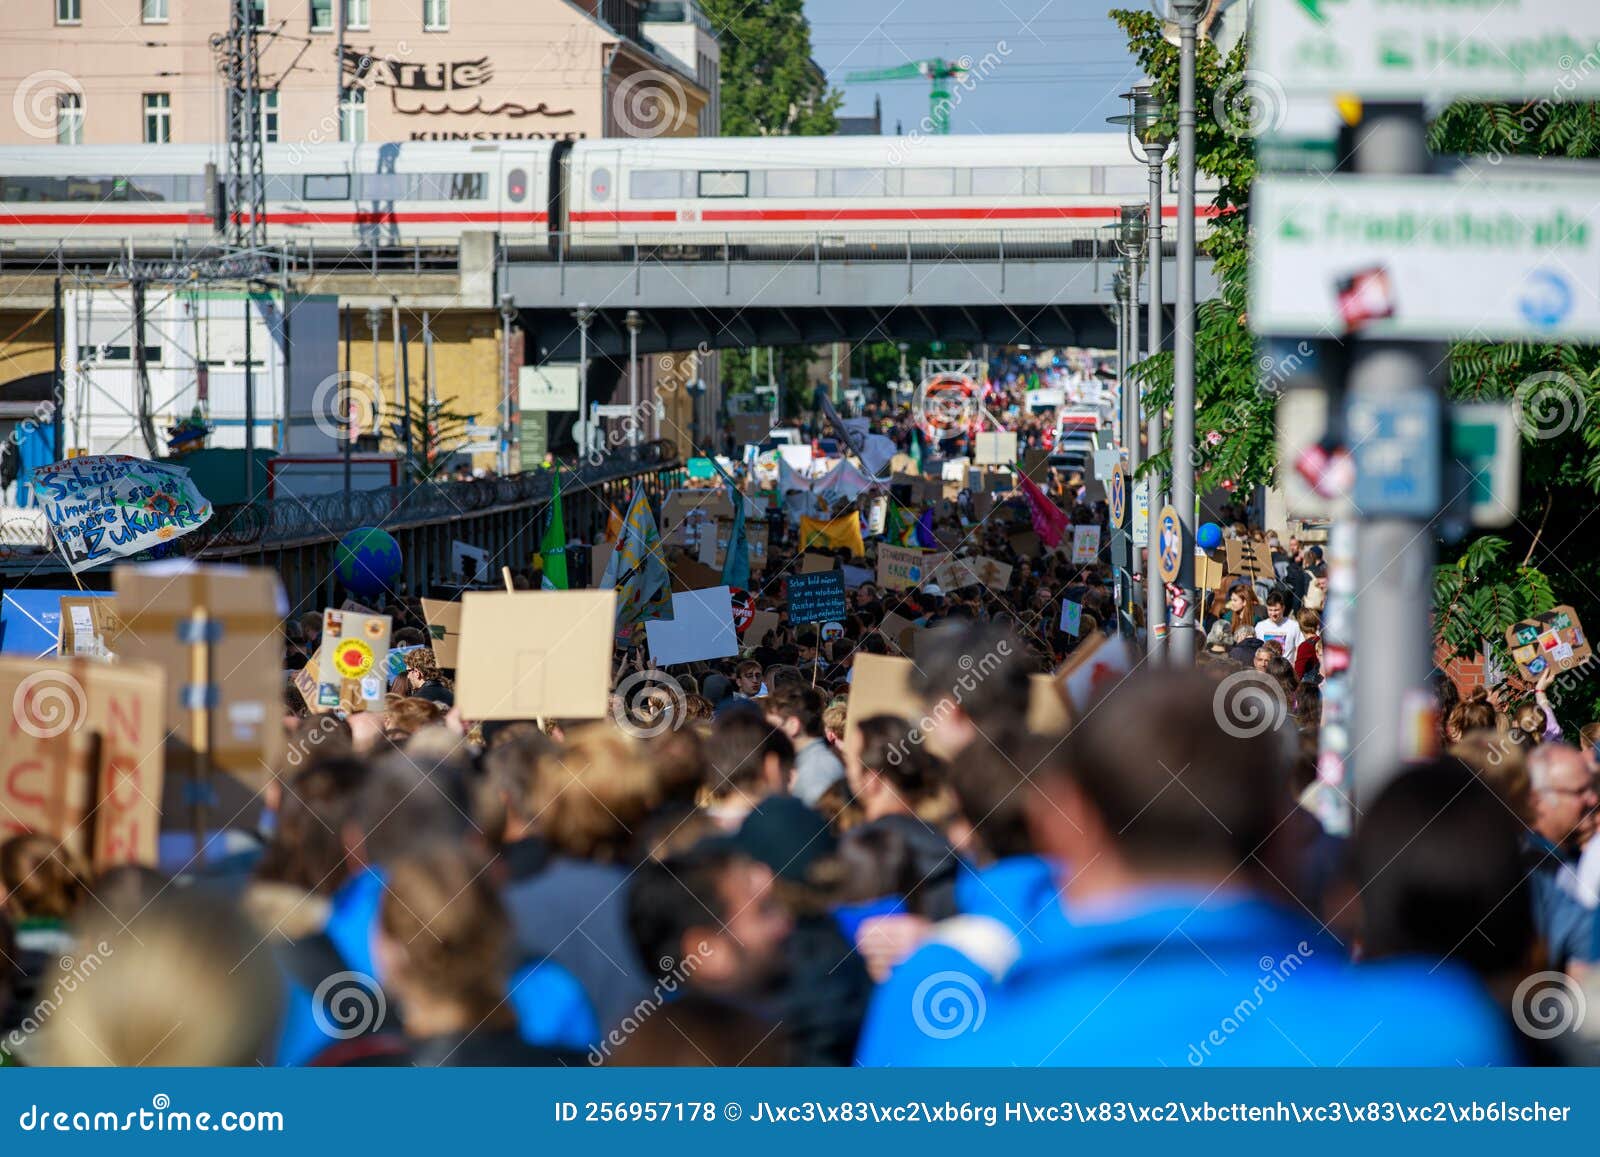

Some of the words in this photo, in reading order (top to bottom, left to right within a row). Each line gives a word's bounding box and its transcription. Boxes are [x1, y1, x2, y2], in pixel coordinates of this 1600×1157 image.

[127, 486, 155, 504] sie
[159, 478, 178, 494] ist
[83, 500, 202, 560] Zukunft
